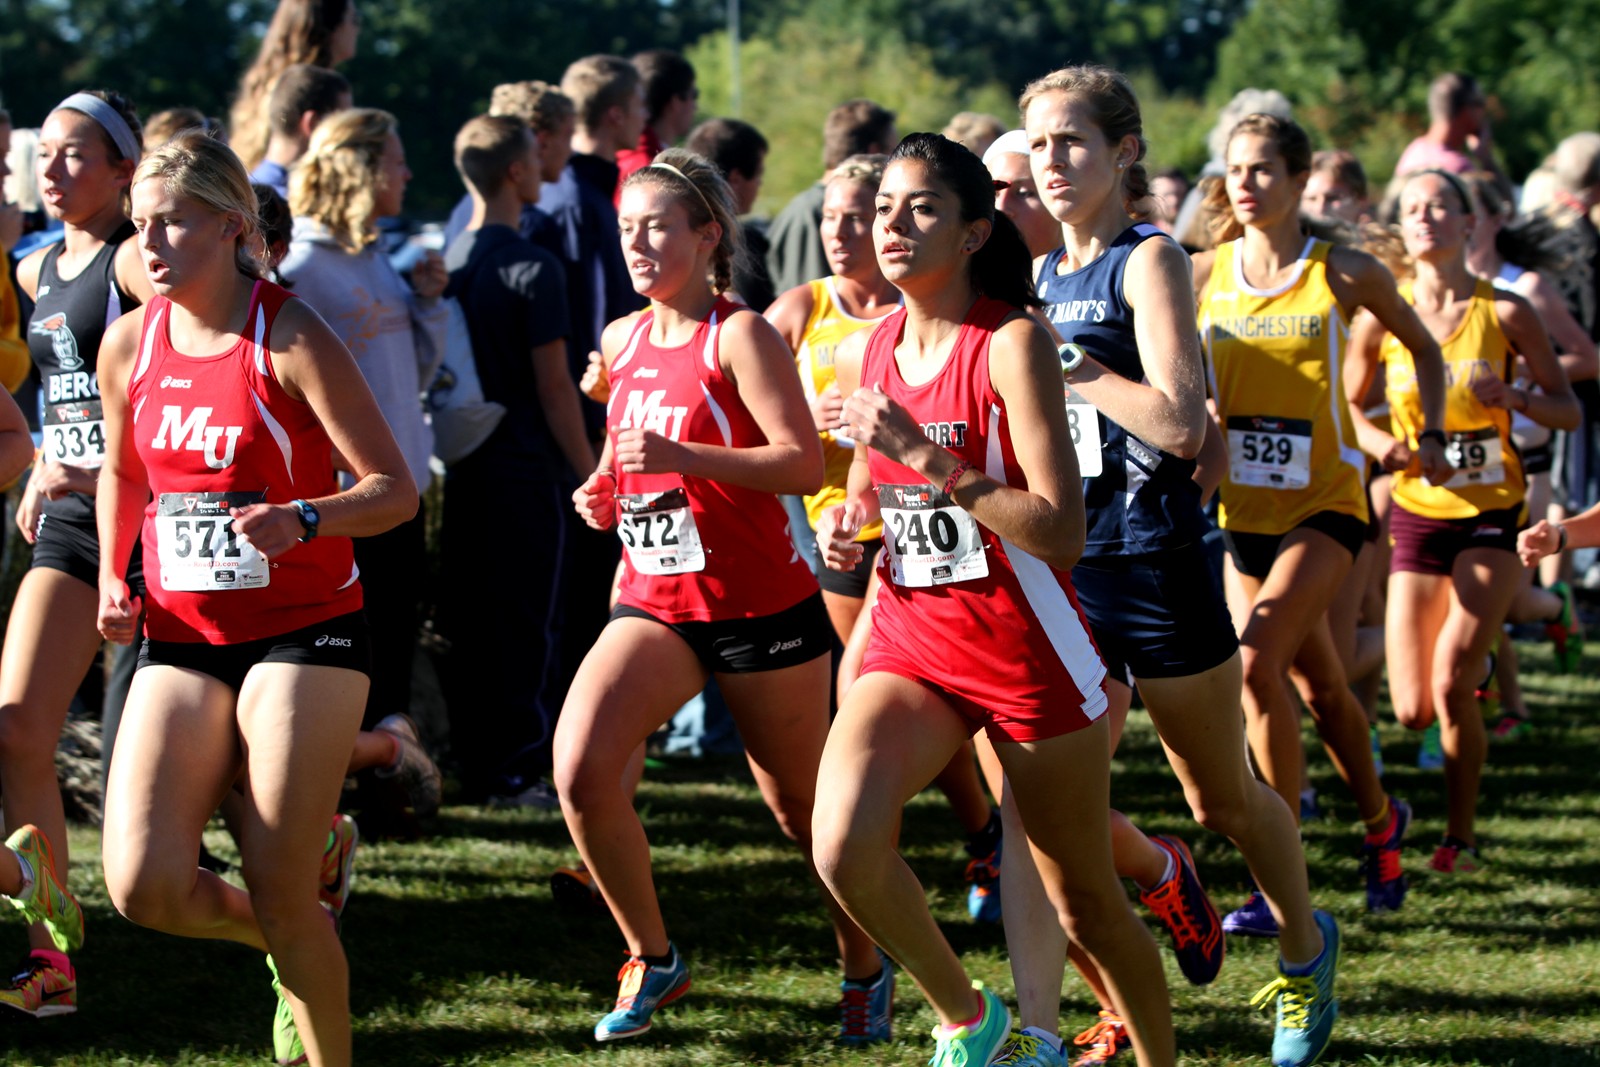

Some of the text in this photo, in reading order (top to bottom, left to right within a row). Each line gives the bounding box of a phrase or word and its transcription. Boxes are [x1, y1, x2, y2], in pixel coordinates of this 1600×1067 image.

[1051, 300, 1107, 324] MARY'S
[1213, 315, 1322, 340] MANCHESTER
[54, 423, 105, 459] 334
[151, 404, 243, 469] MU
[1242, 434, 1293, 466] 529
[174, 518, 241, 558] 571
[893, 510, 959, 556] 240
[328, 637, 352, 647] asics
